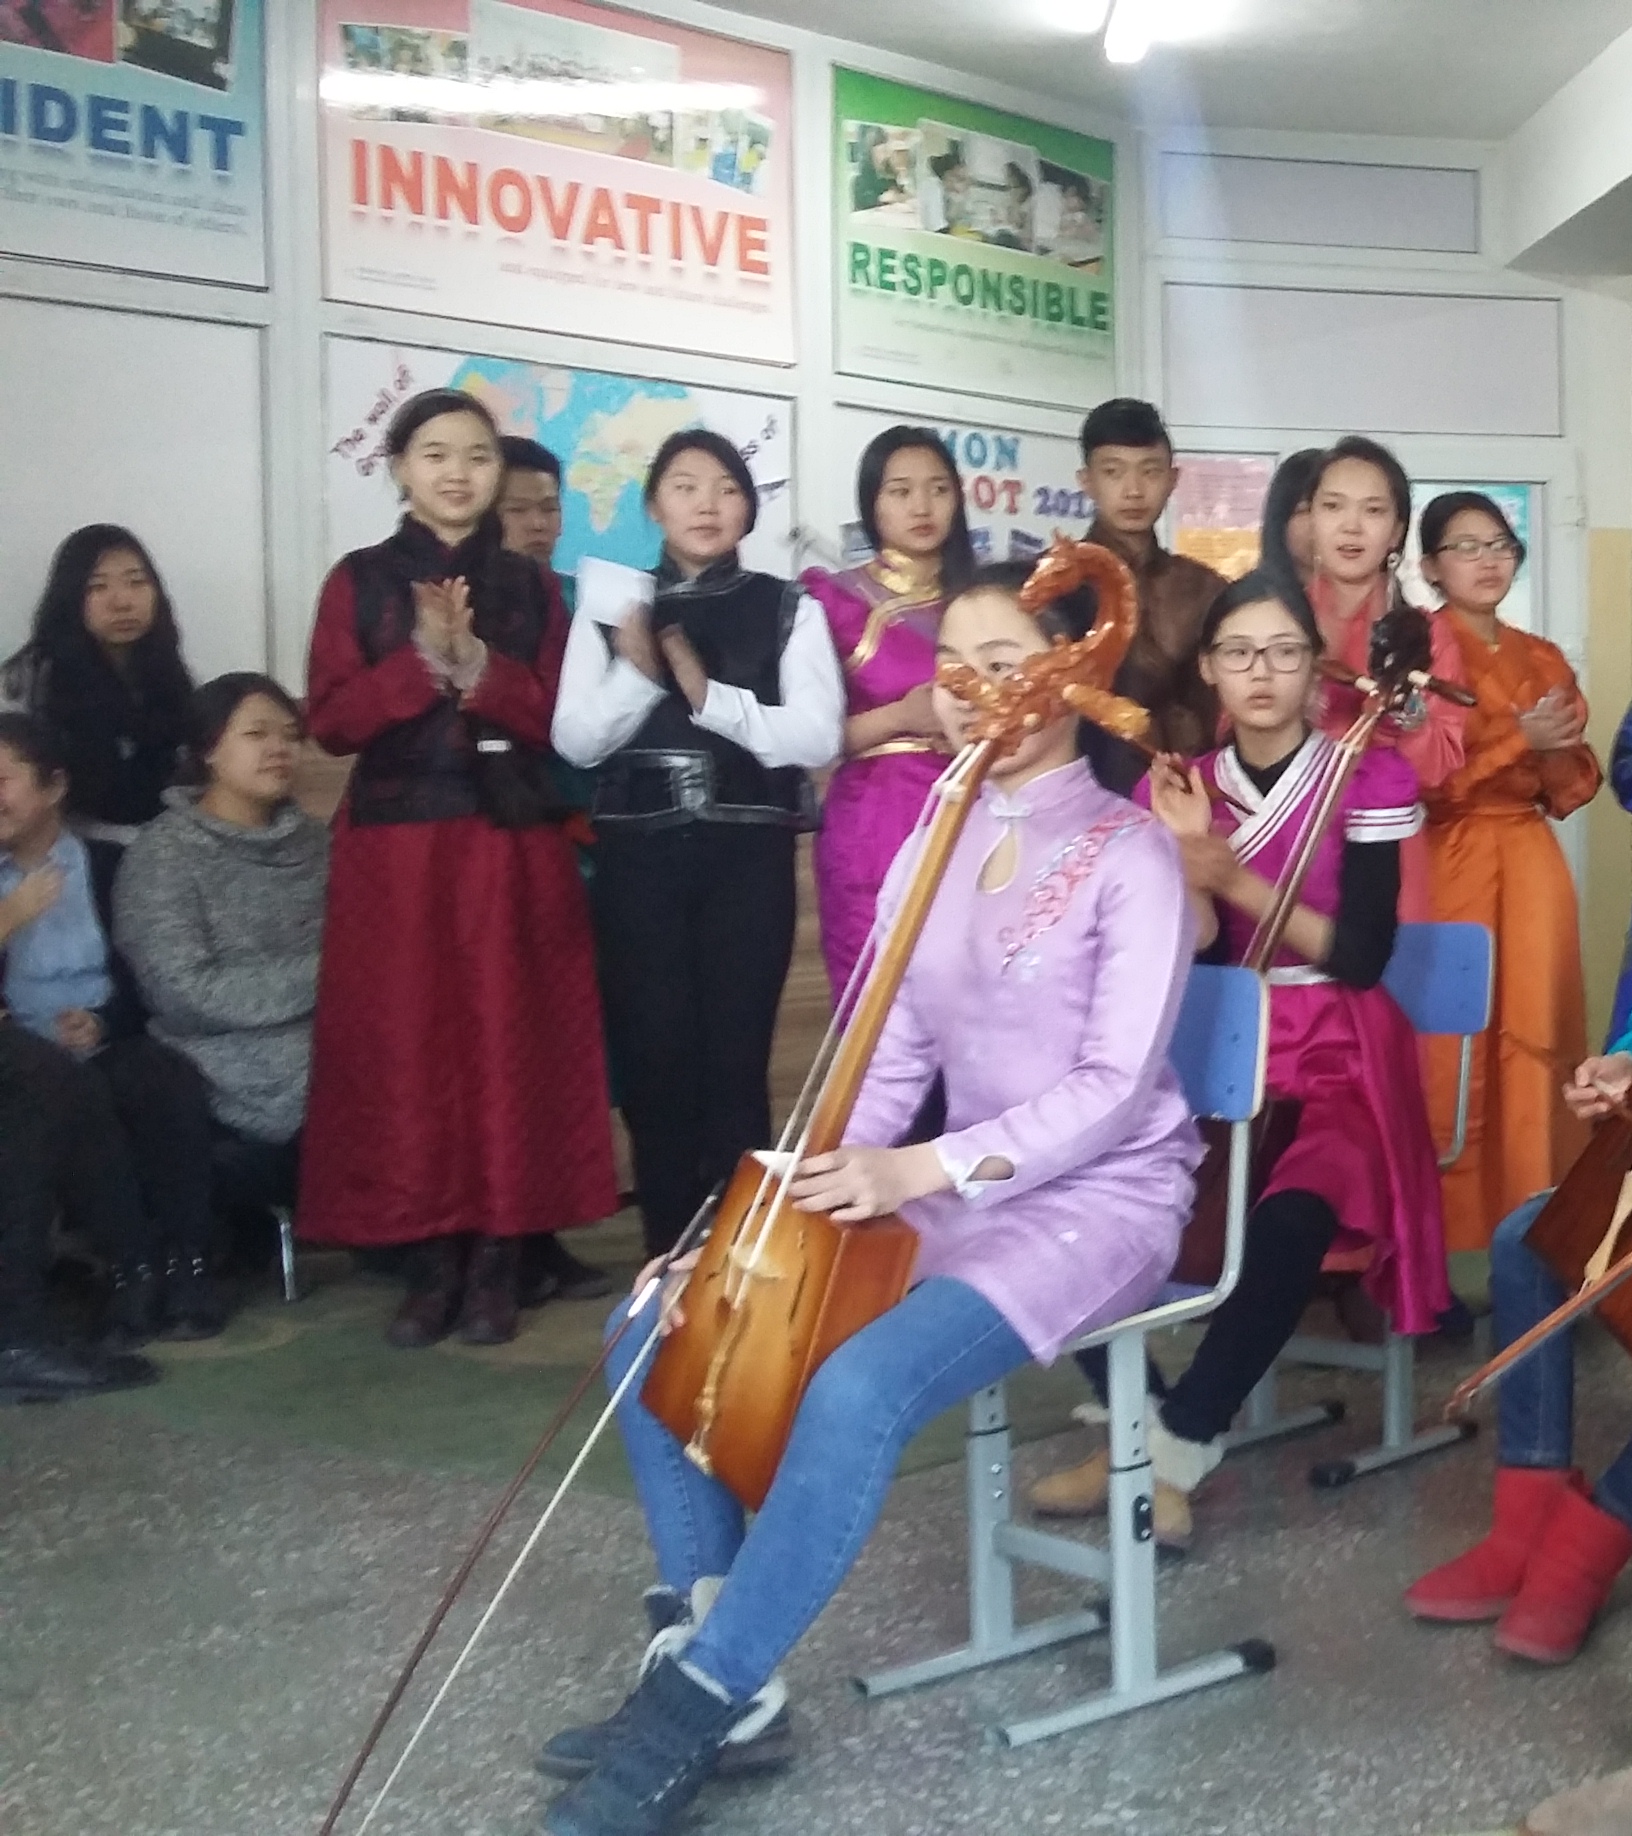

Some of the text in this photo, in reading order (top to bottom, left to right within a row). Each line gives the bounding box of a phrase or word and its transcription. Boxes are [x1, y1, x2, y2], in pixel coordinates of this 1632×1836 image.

[0, 77, 245, 172] IDENT
[352, 138, 771, 275] INNOVATIVE
[850, 242, 1109, 331] RESPONSIBLE
